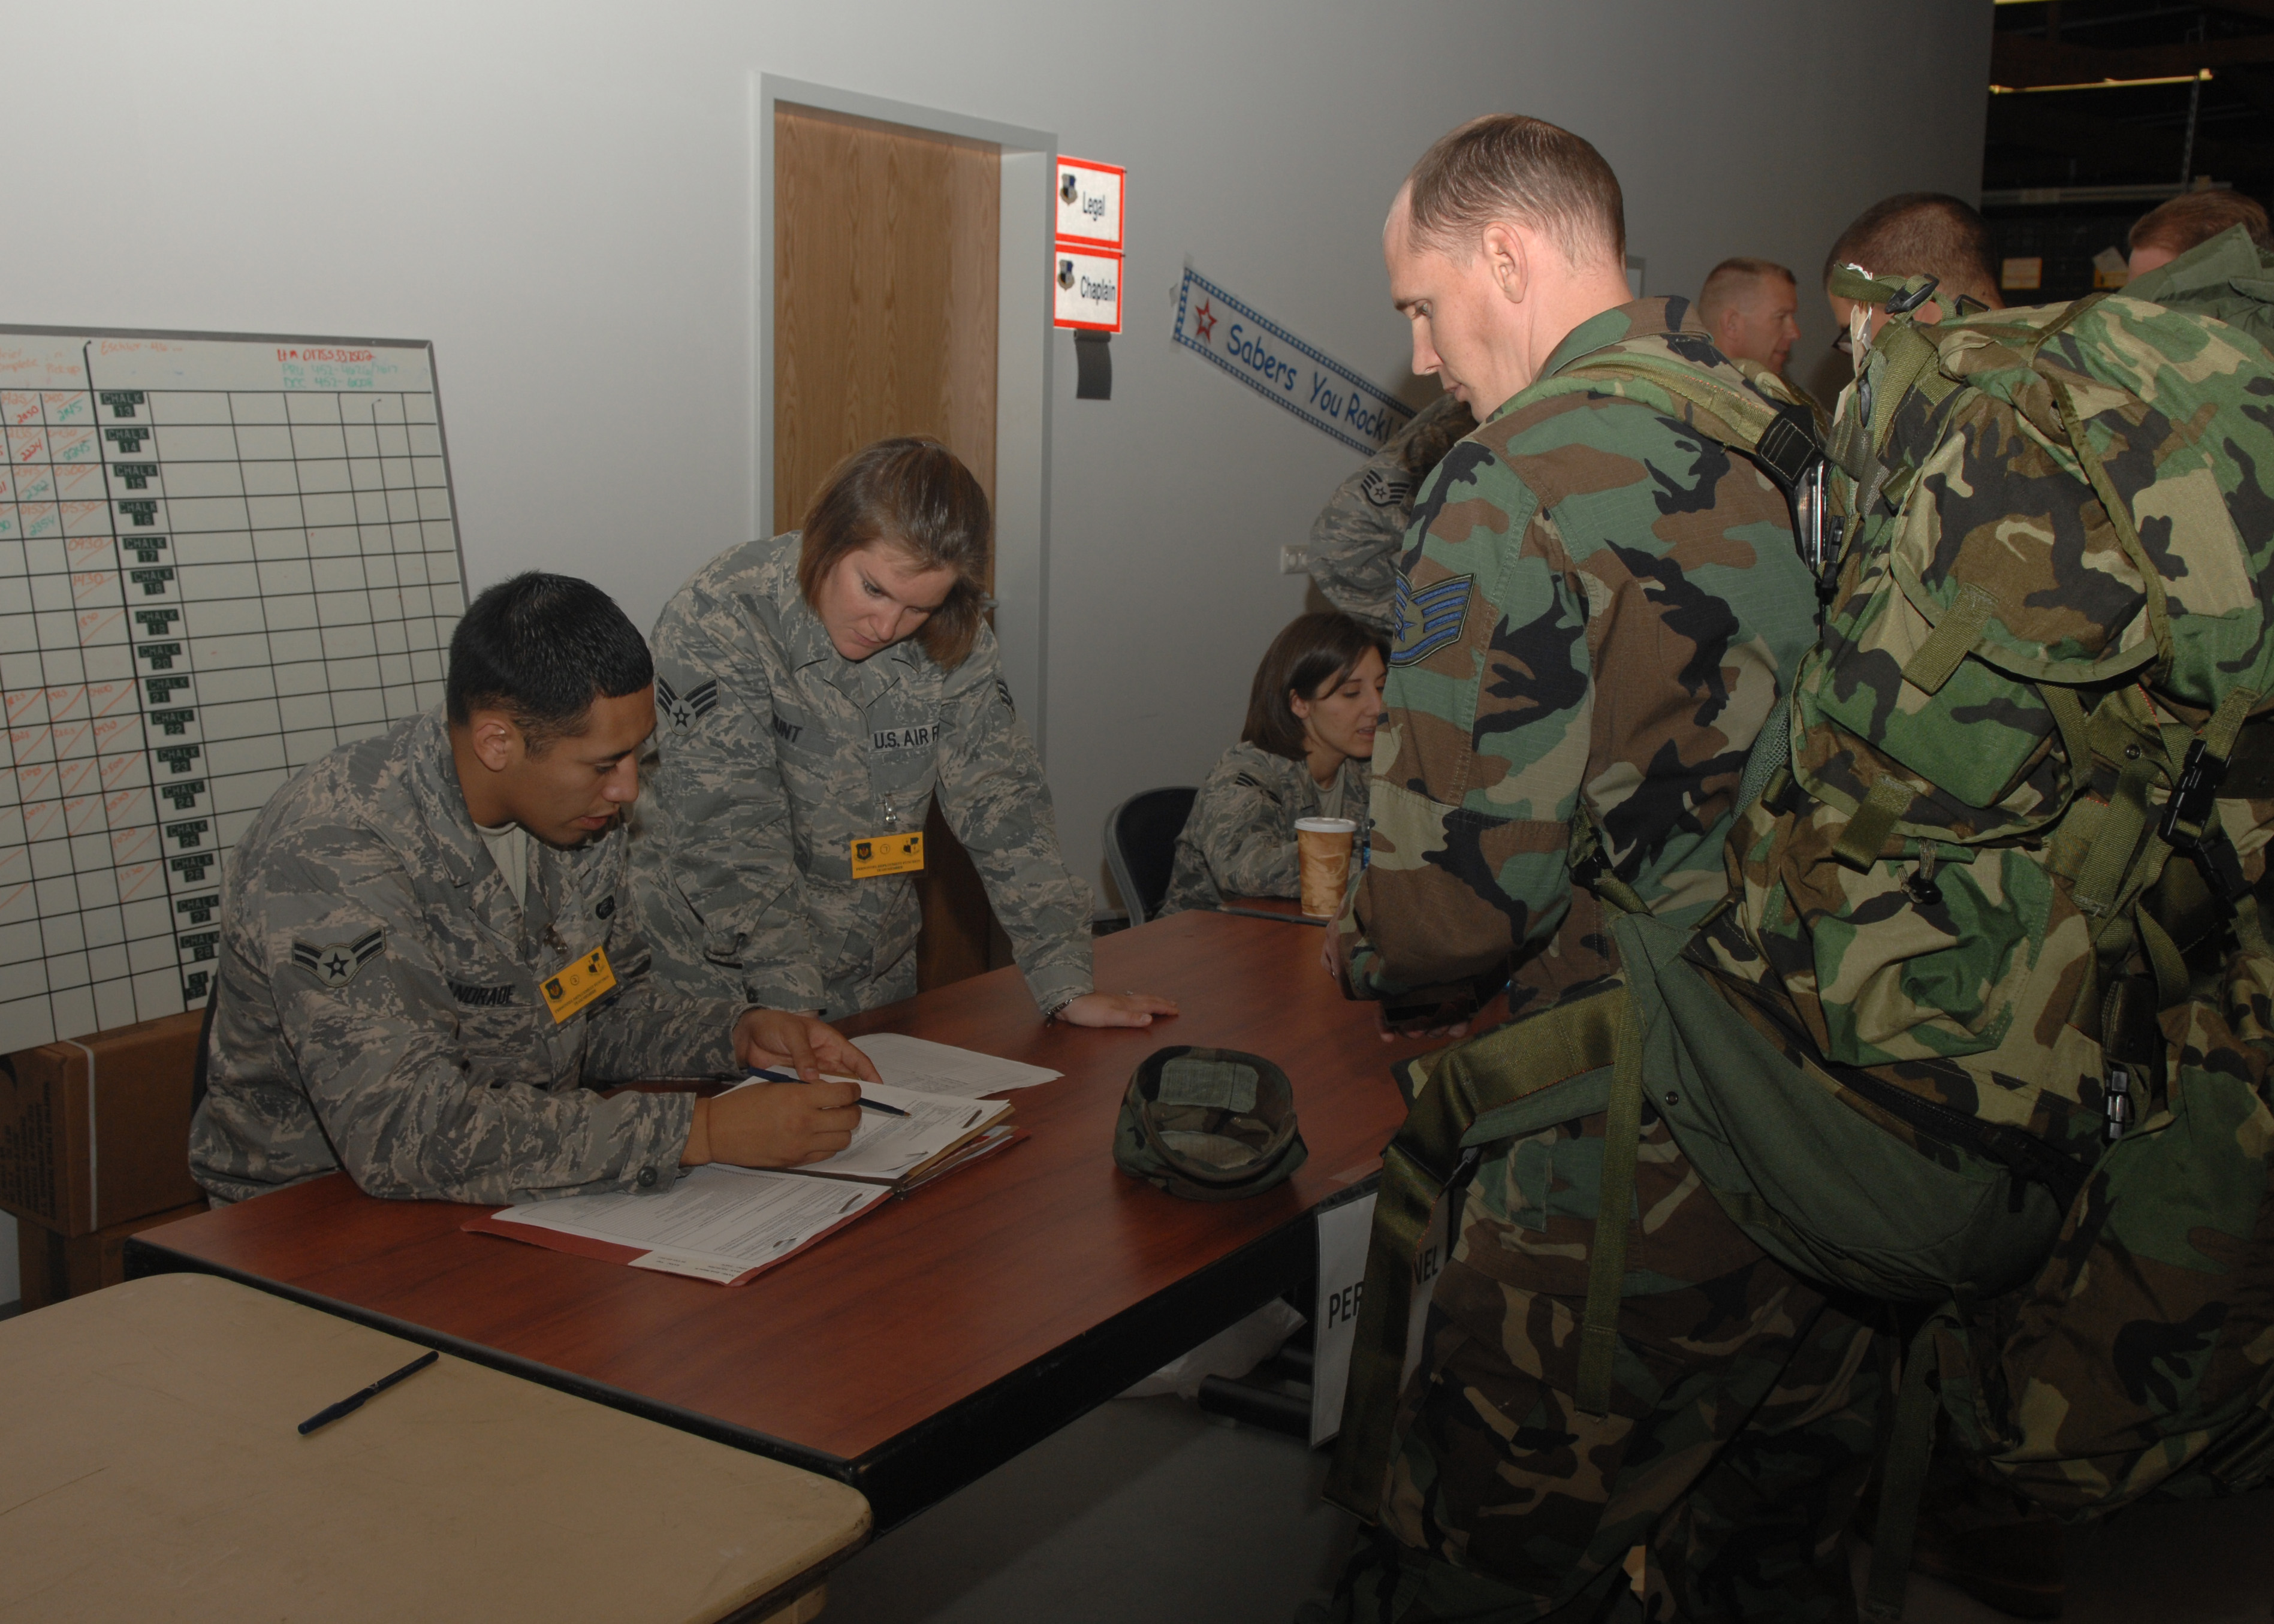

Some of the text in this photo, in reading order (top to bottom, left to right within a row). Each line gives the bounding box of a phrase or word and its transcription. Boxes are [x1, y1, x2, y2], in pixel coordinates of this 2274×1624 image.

[1082, 191, 1105, 221] Legal
[1080, 275, 1116, 306] Chaplain
[1227, 324, 1298, 391] Sabers
[1310, 372, 1343, 417] You
[102, 393, 142, 404] CHALK
[117, 406, 132, 416] 13
[107, 428, 147, 440] CHALK
[123, 442, 138, 452] 14
[116, 464, 155, 476] CHALK
[129, 478, 144, 488] 15
[119, 502, 157, 513] CHALK
[125, 538, 165, 549] CHALK
[141, 551, 156, 562] 17
[134, 569, 172, 582] CHALK
[138, 609, 177, 622] CHALK
[141, 644, 179, 657] CHALK
[154, 658, 169, 669] 20
[149, 678, 188, 690] CHALK
[152, 693, 167, 702] 21
[153, 711, 192, 724] CHALK
[167, 725, 183, 734] 22
[773, 713, 803, 743] UNT
[873, 731, 900, 749] U.S.
[904, 728, 929, 747] AIR
[160, 747, 198, 761] CHALK
[173, 762, 189, 772] 23
[165, 782, 203, 797] CHALK
[177, 797, 192, 808] 24
[170, 822, 207, 837] CHALK
[174, 856, 212, 870] CHALK
[180, 896, 217, 911] CHALK
[183, 932, 219, 947] CHALK
